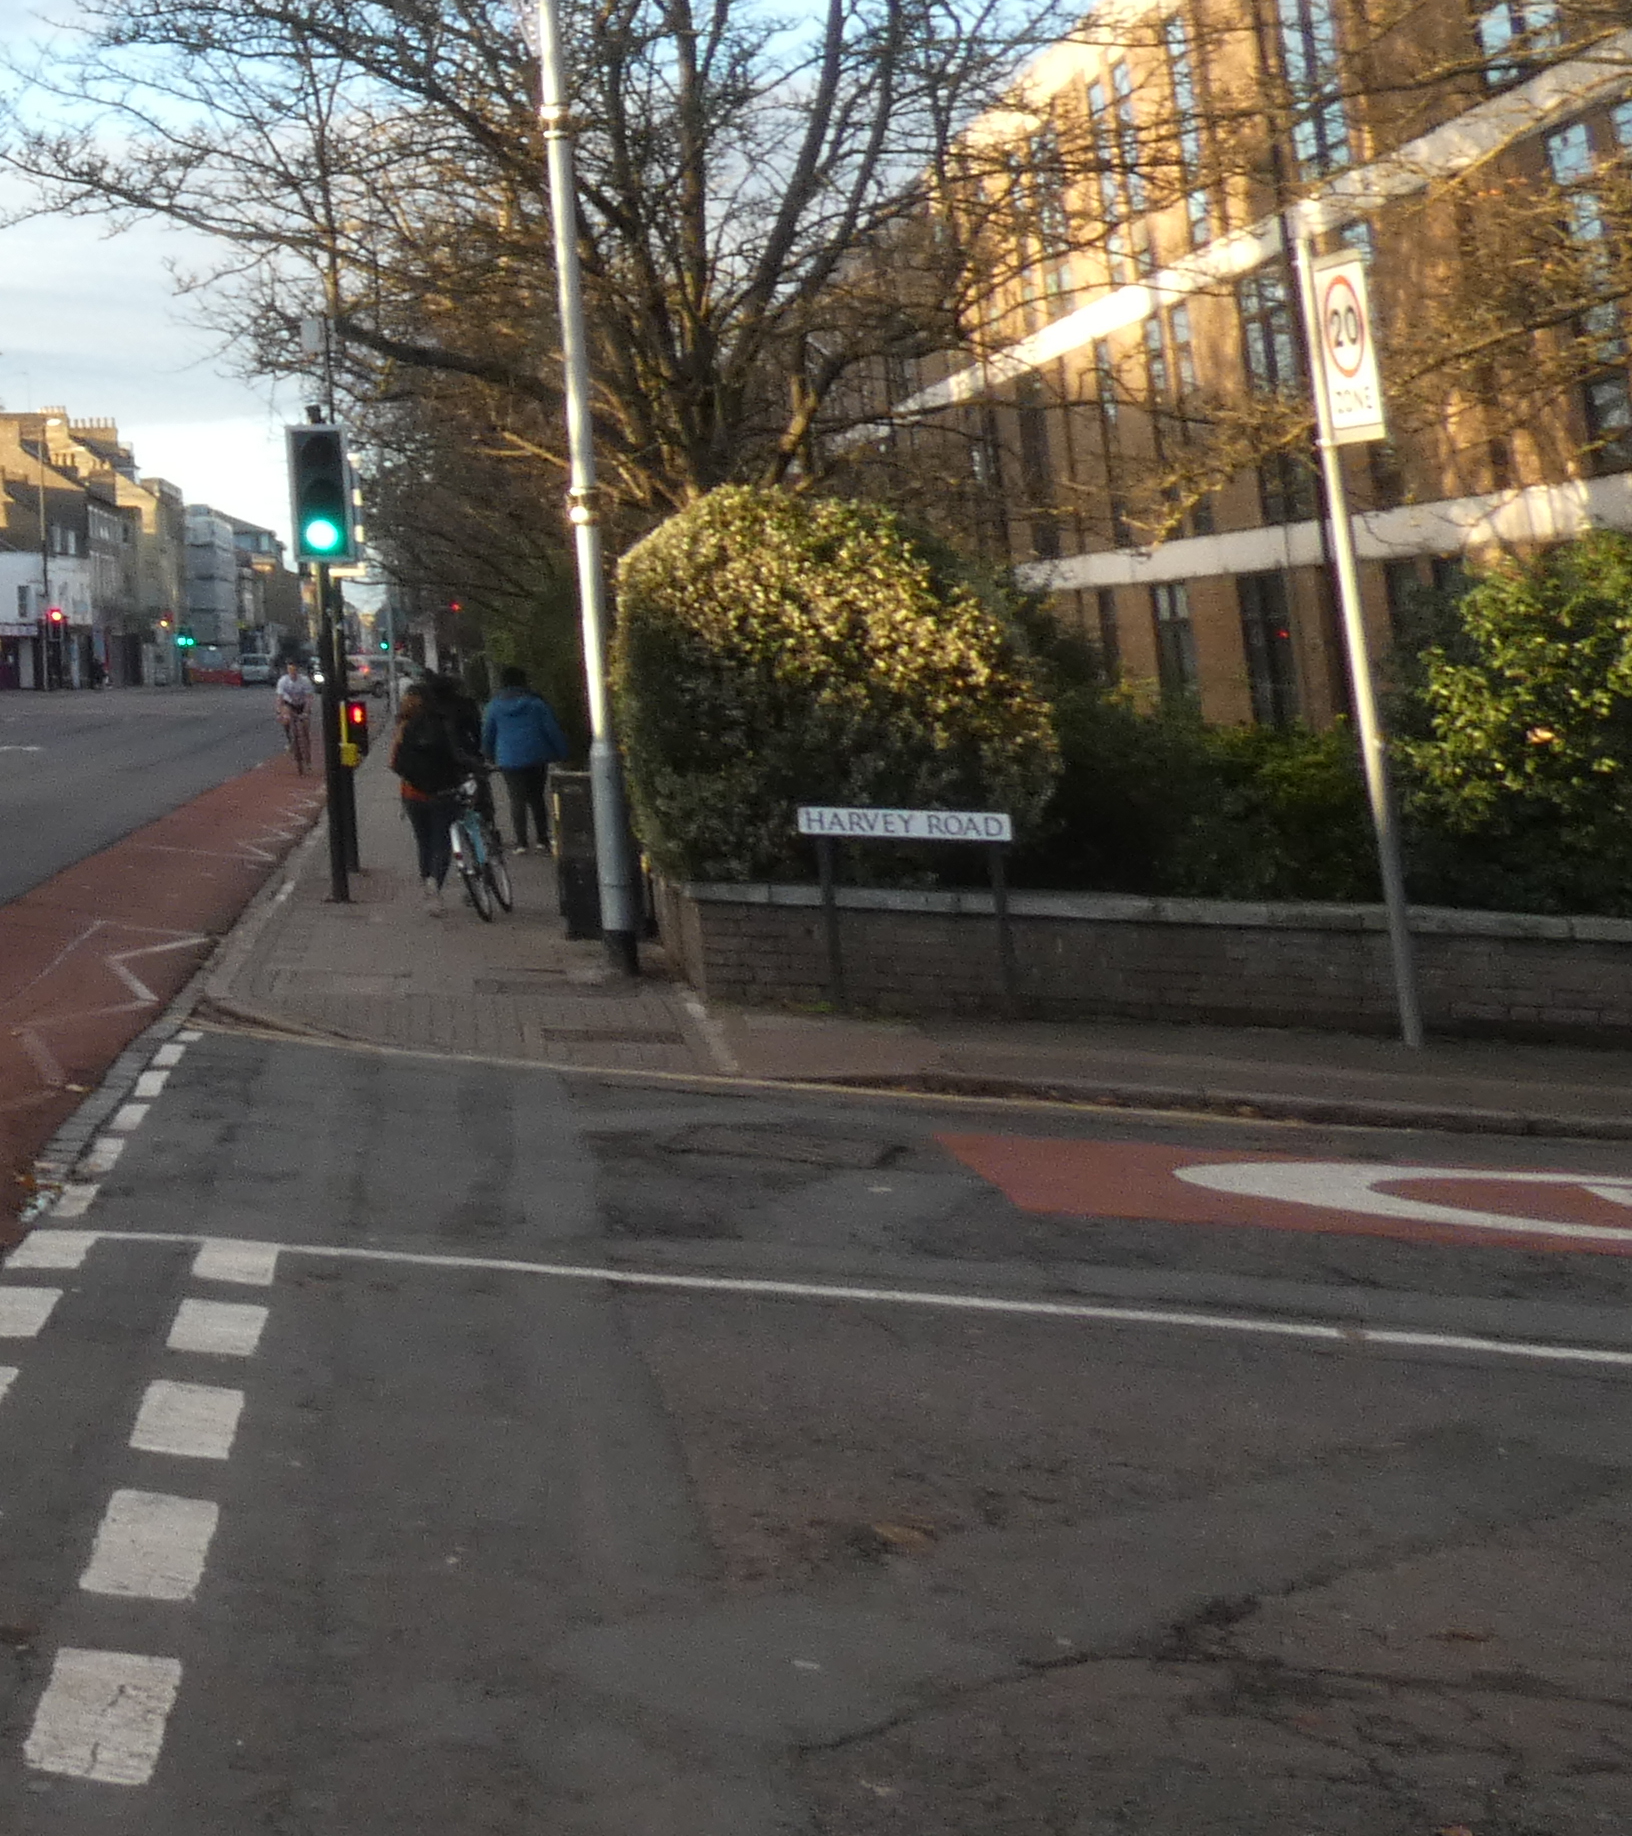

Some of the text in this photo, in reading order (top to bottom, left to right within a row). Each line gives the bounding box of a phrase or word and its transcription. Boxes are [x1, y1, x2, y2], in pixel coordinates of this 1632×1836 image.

[1330, 305, 1358, 348] 20
[805, 810, 1004, 838] HARVEY ROAD
